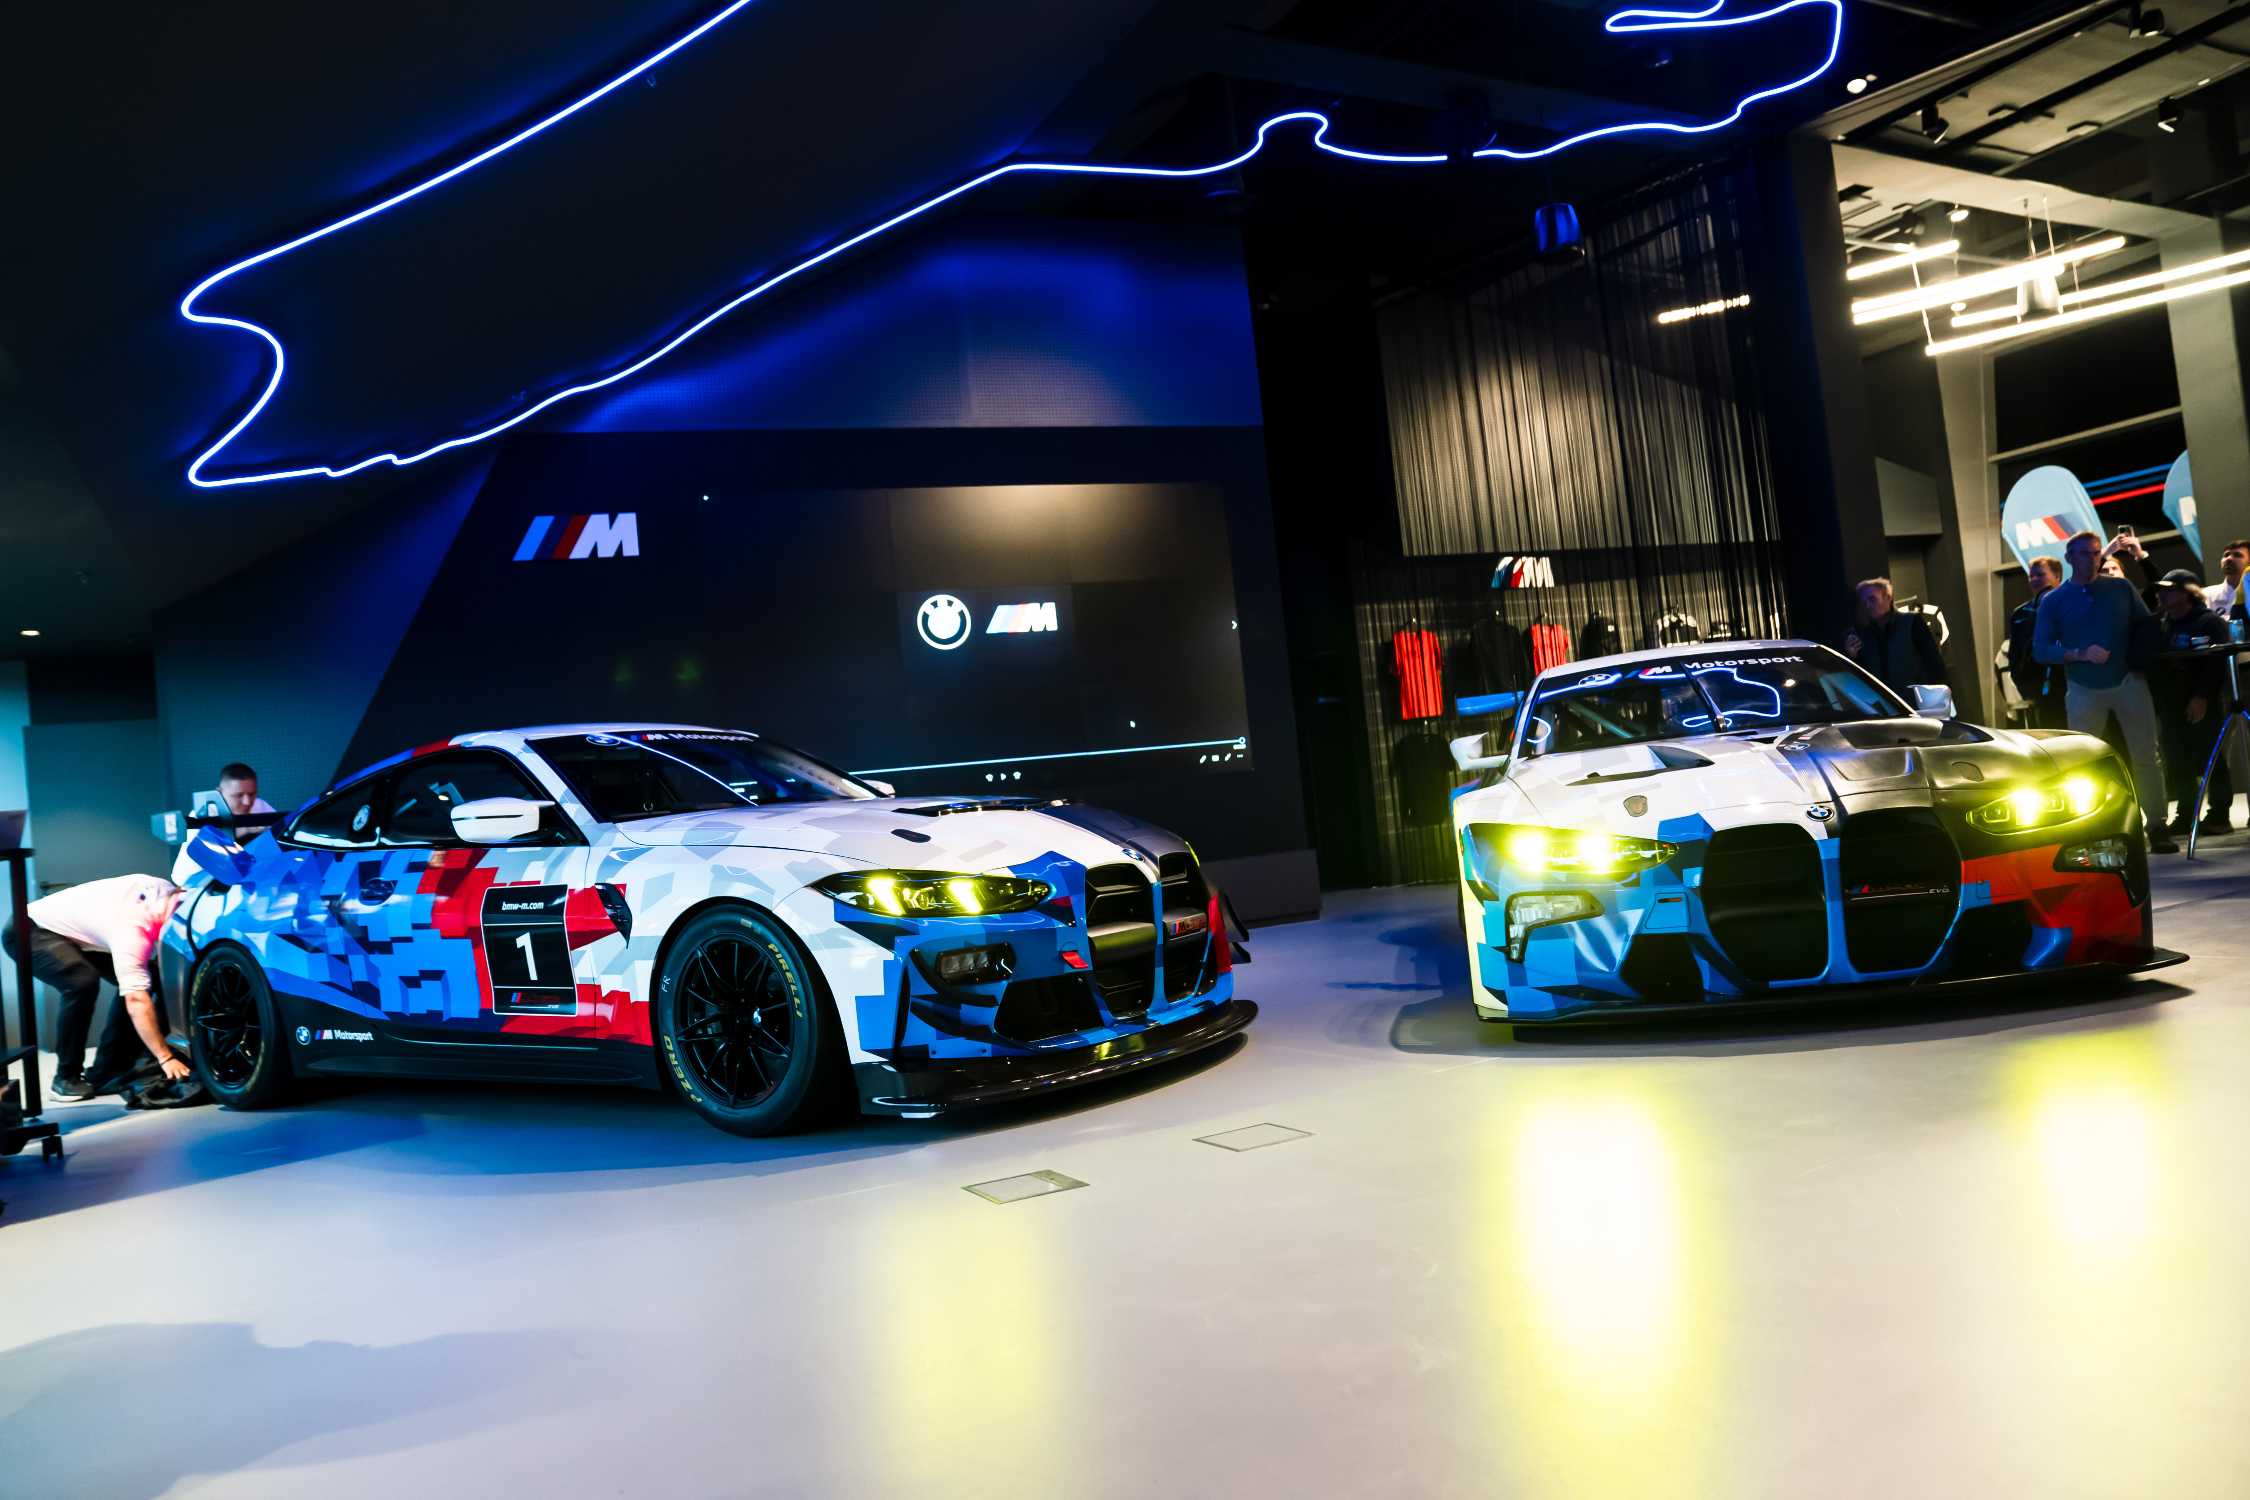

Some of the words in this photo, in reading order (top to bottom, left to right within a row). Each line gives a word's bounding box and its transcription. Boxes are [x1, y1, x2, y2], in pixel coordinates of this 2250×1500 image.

[569, 512, 640, 559] M
[2015, 518, 2060, 550] M
[1518, 556, 1554, 588] M
[1647, 665, 1673, 675] M
[1684, 655, 1804, 670] Motorsport
[501, 901, 544, 911] bmw-m.com
[515, 931, 538, 981] 1
[661, 975, 671, 993] FR
[768, 943, 802, 1018] PIRELLI
[333, 1029, 374, 1042] Motorsport
[664, 1034, 693, 1091] ZERO
